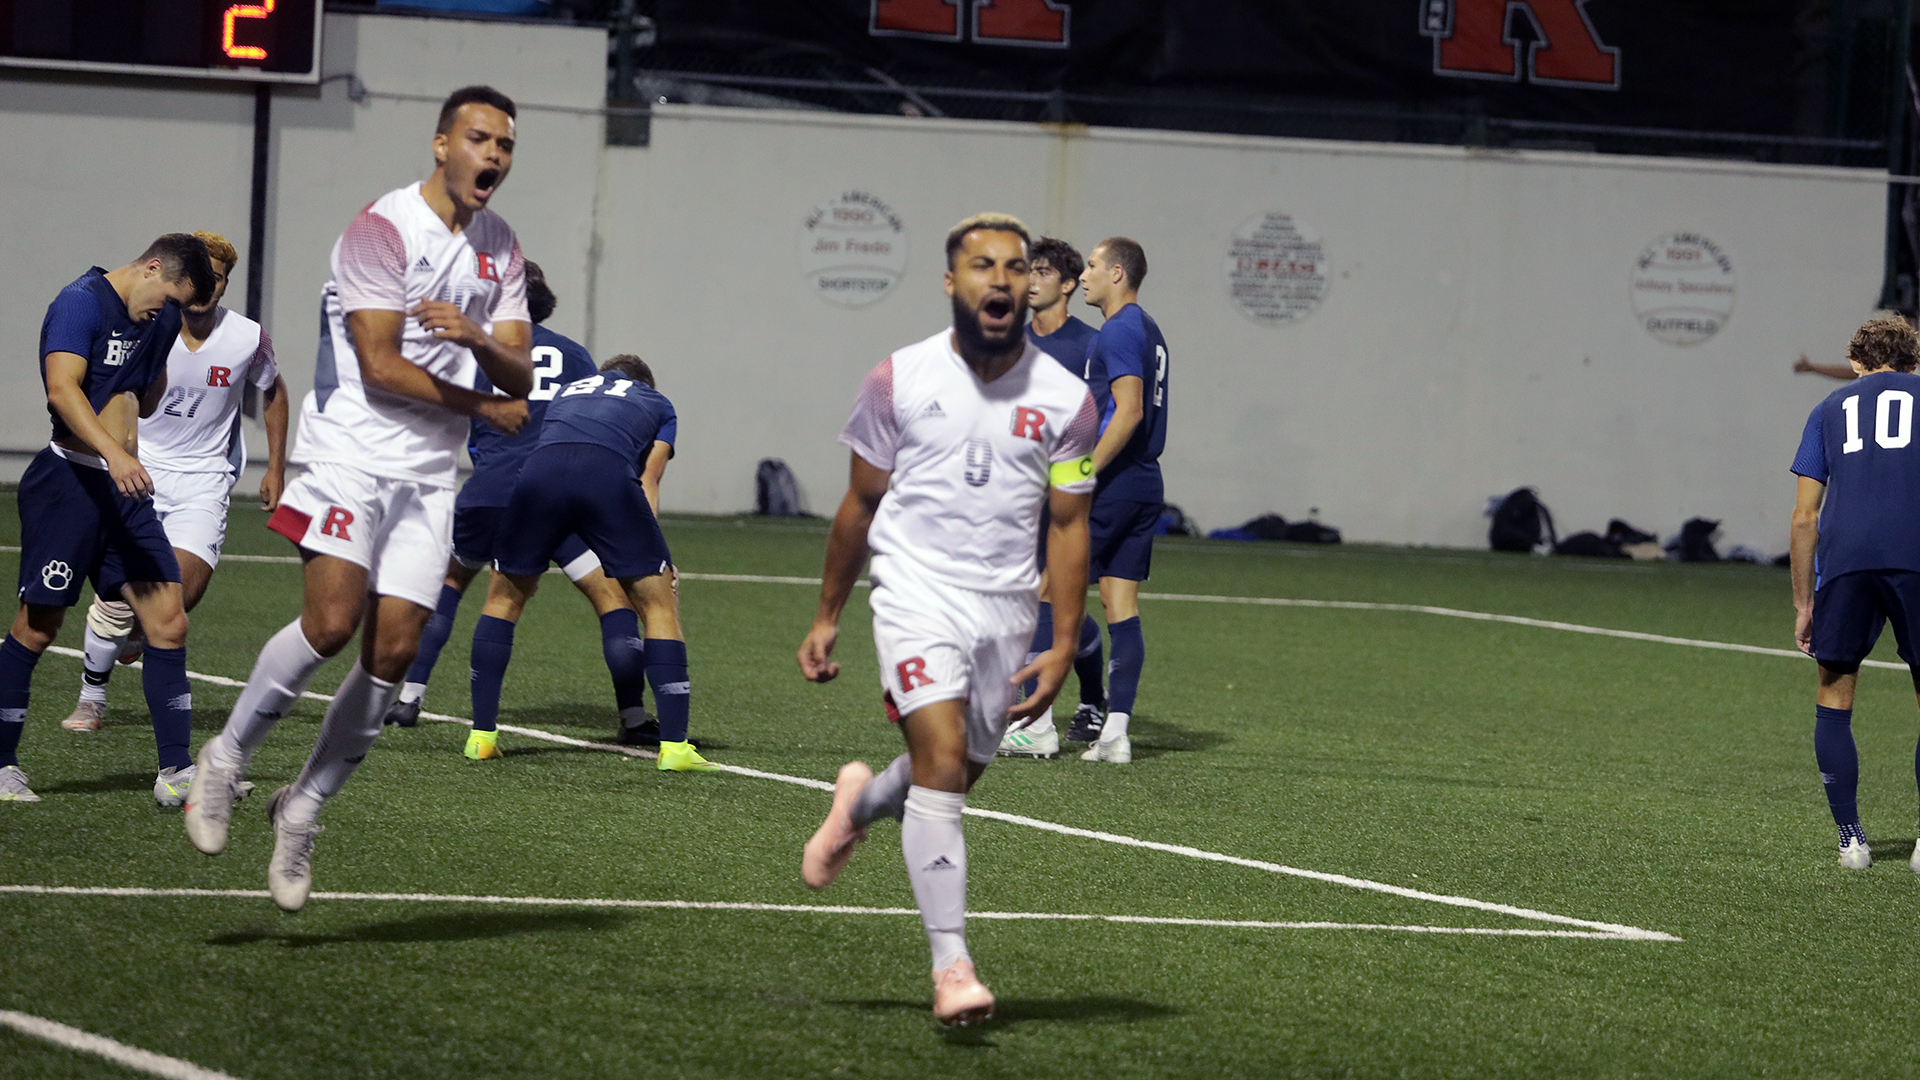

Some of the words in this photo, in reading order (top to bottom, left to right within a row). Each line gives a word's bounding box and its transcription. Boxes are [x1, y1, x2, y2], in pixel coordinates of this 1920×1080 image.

[222, 0, 275, 59] 2
[811, 237, 840, 254] Jim
[207, 366, 231, 387] R
[560, 374, 633, 398] 21
[164, 385, 207, 418] 27
[1012, 406, 1045, 442] R
[1841, 389, 1914, 455] 10
[964, 438, 993, 488] 9
[1079, 457, 1092, 477] C
[321, 506, 354, 542] R
[896, 656, 935, 693] R
